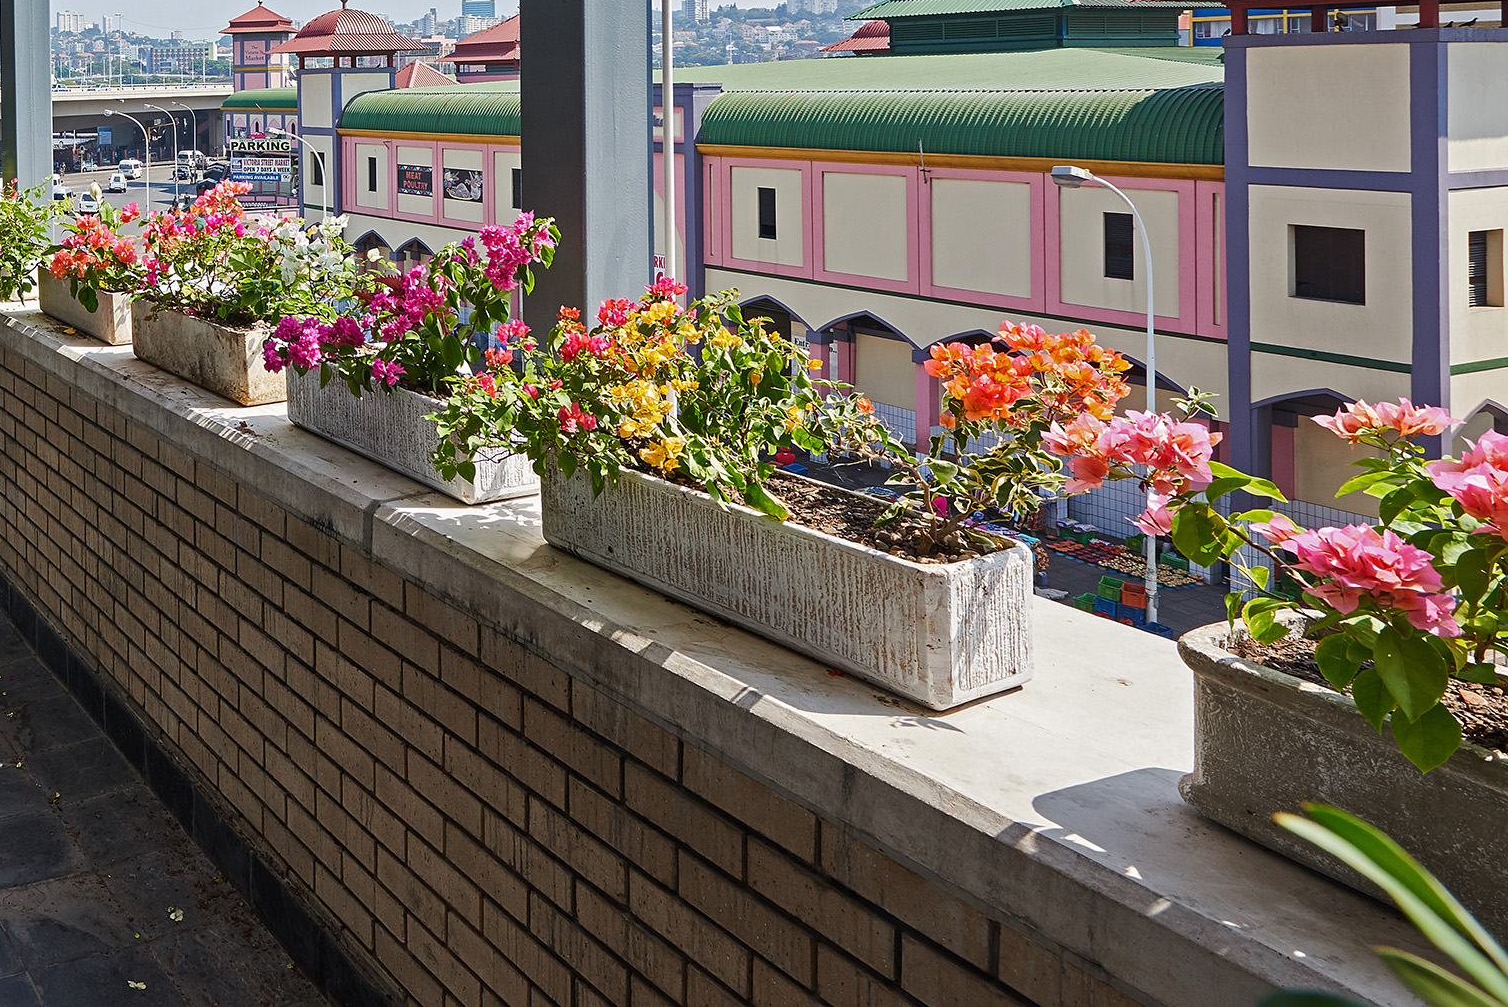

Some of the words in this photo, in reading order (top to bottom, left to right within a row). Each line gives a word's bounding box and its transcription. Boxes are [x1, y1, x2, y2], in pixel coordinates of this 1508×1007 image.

[231, 141, 290, 151] PARKING
[406, 171, 421, 180] MEAT
[403, 180, 428, 189] POULTRY
